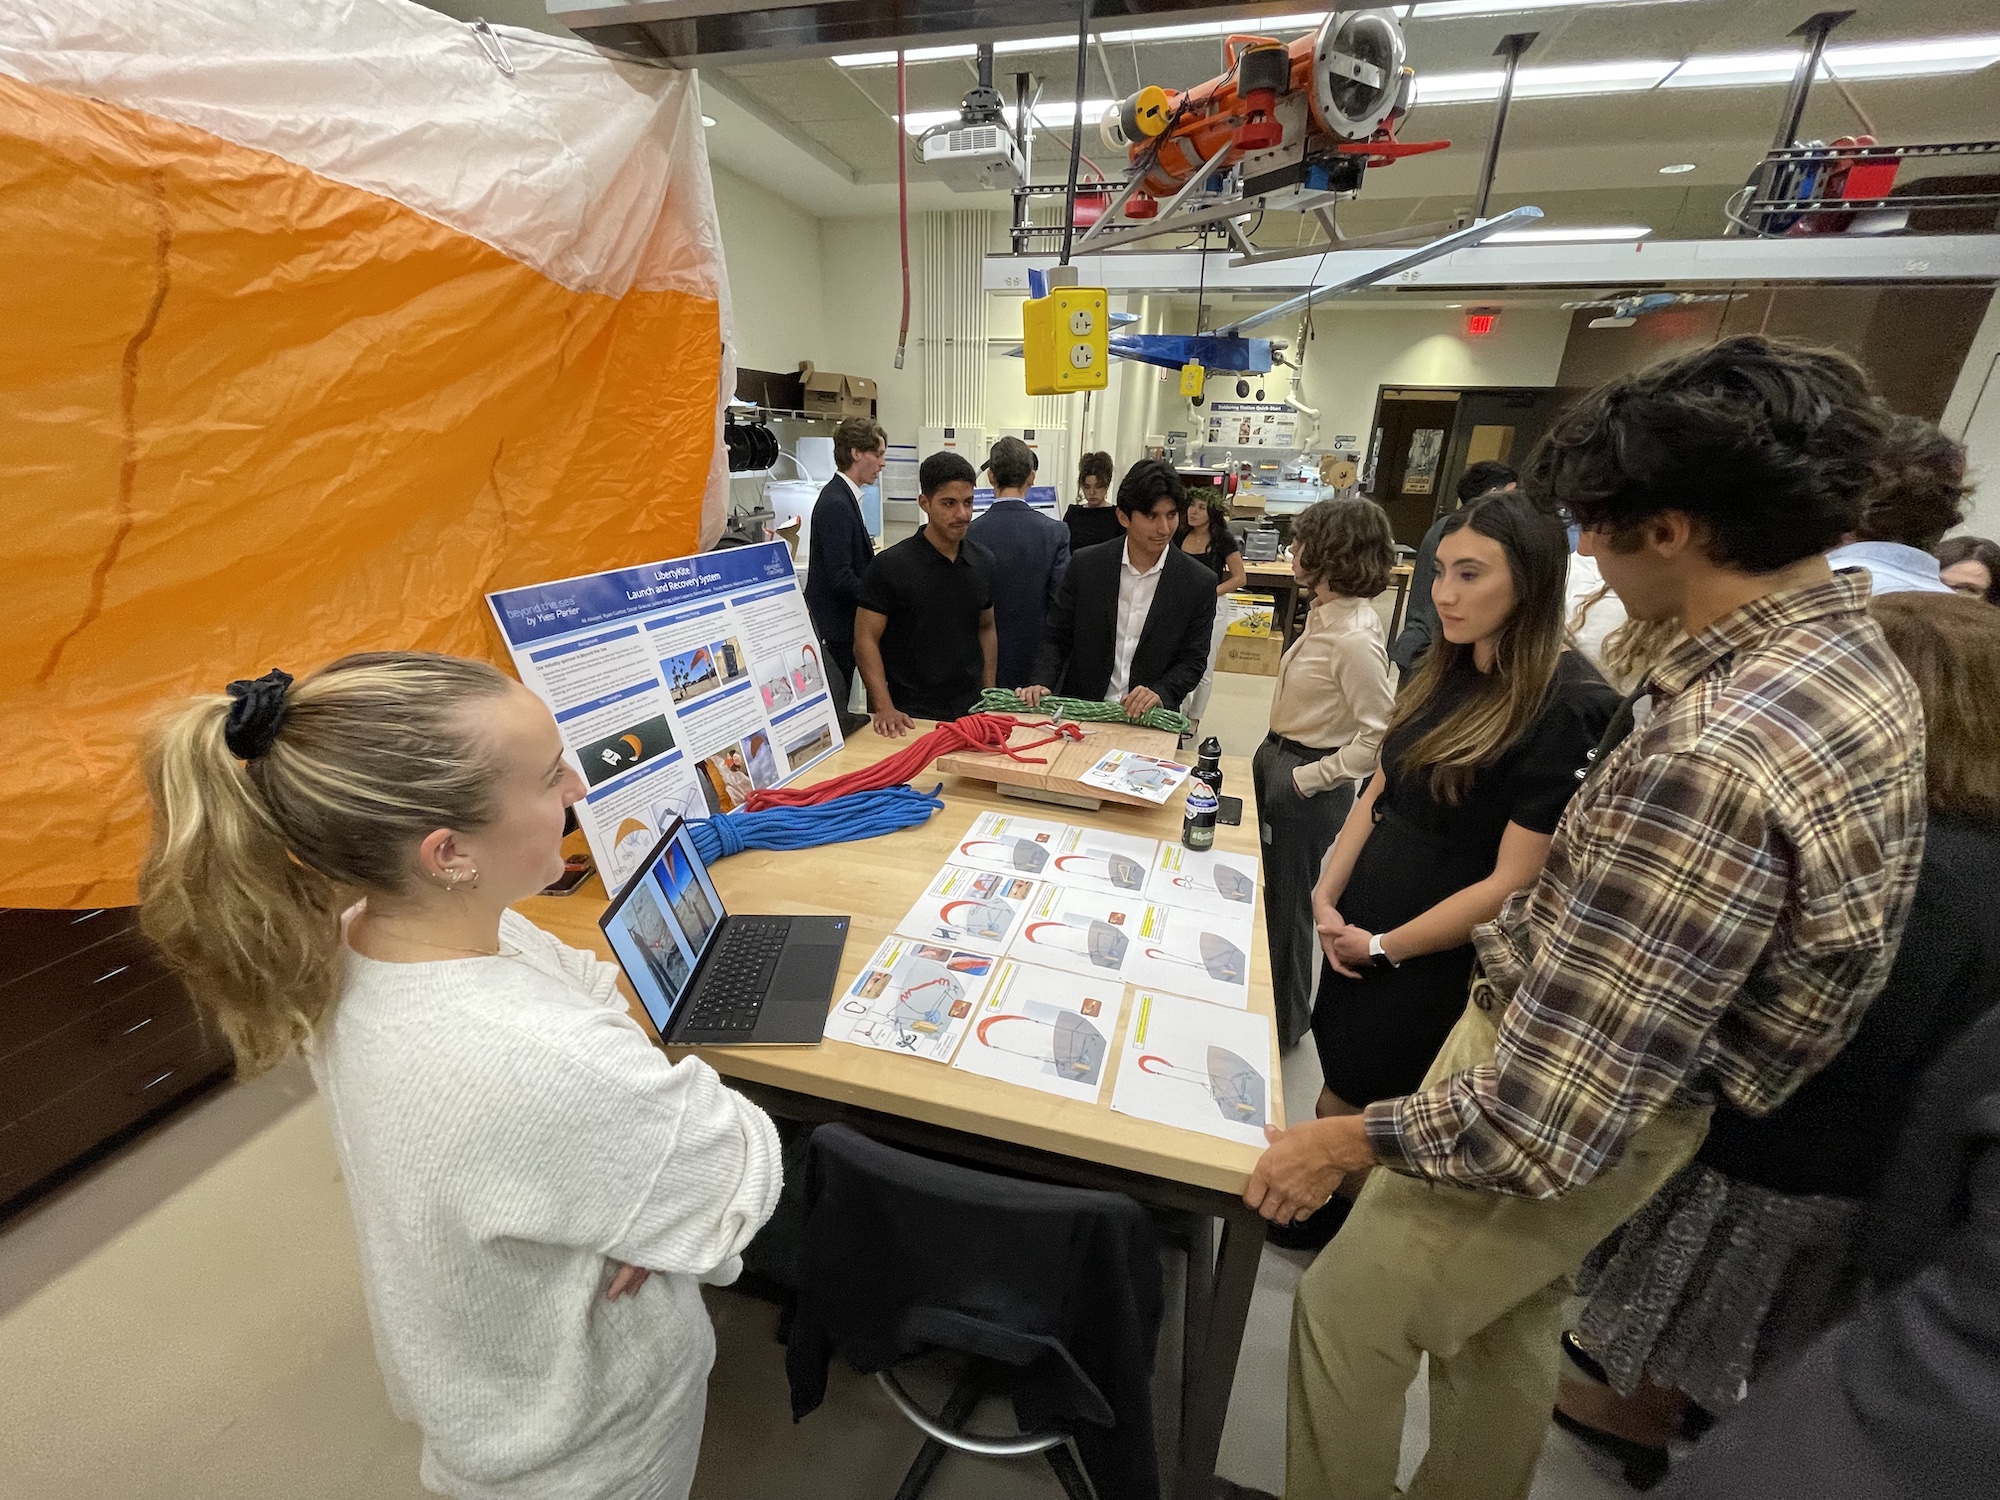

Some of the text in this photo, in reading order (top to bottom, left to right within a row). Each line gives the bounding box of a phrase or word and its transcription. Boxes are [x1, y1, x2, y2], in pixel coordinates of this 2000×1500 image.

[1470, 316, 1494, 334] EXIT
[654, 566, 691, 581] LibertyKite
[626, 587, 655, 600] Launch
[656, 583, 669, 594] and
[669, 577, 699, 591] Recovery
[699, 573, 721, 585] System
[505, 604, 541, 619] beyond
[541, 601, 557, 612] the
[526, 615, 537, 627] by
[537, 611, 556, 622] Yves
